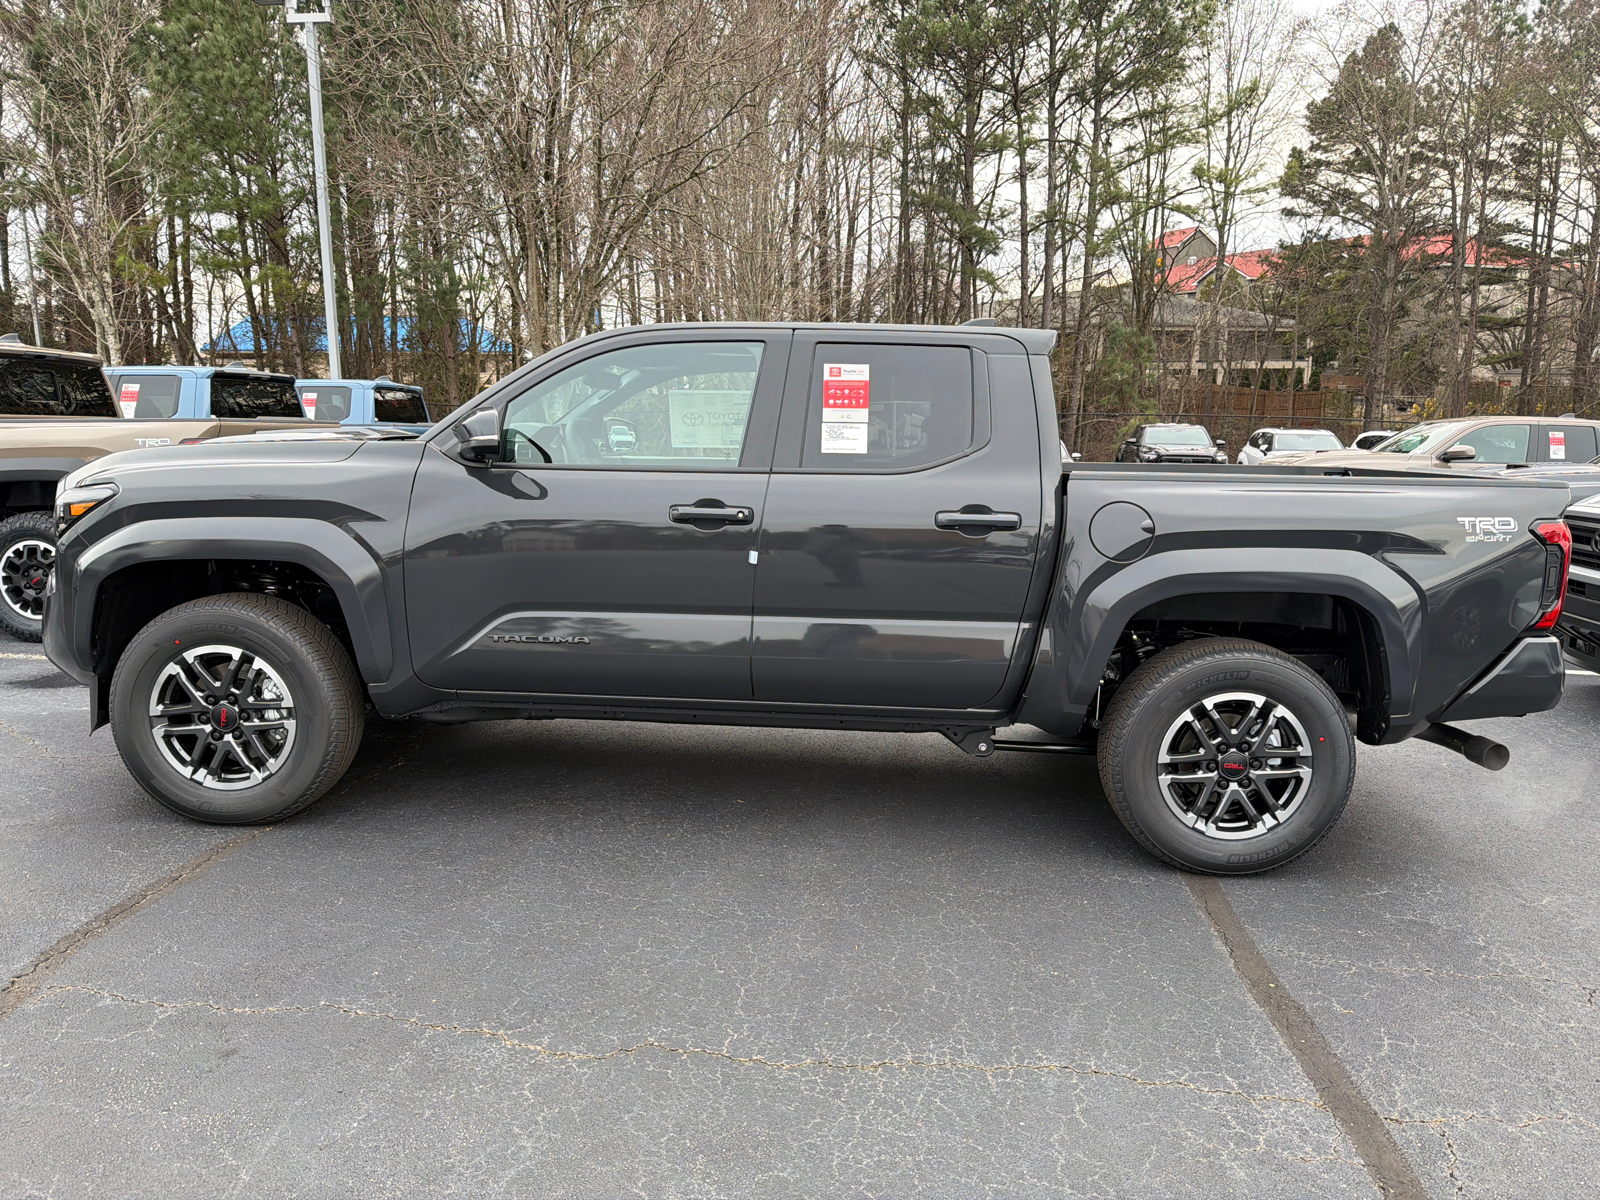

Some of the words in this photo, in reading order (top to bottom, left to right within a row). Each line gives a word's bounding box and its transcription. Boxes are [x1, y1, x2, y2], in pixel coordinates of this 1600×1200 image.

[133, 438, 171, 448] TRD
[1457, 517, 1518, 534] TRD
[1466, 533, 1513, 542] SPORT
[487, 634, 590, 645] TACOMA
[1186, 671, 1249, 691] MICHELIN
[1223, 762, 1245, 770] TRD
[1229, 842, 1289, 863] MICHELIN
